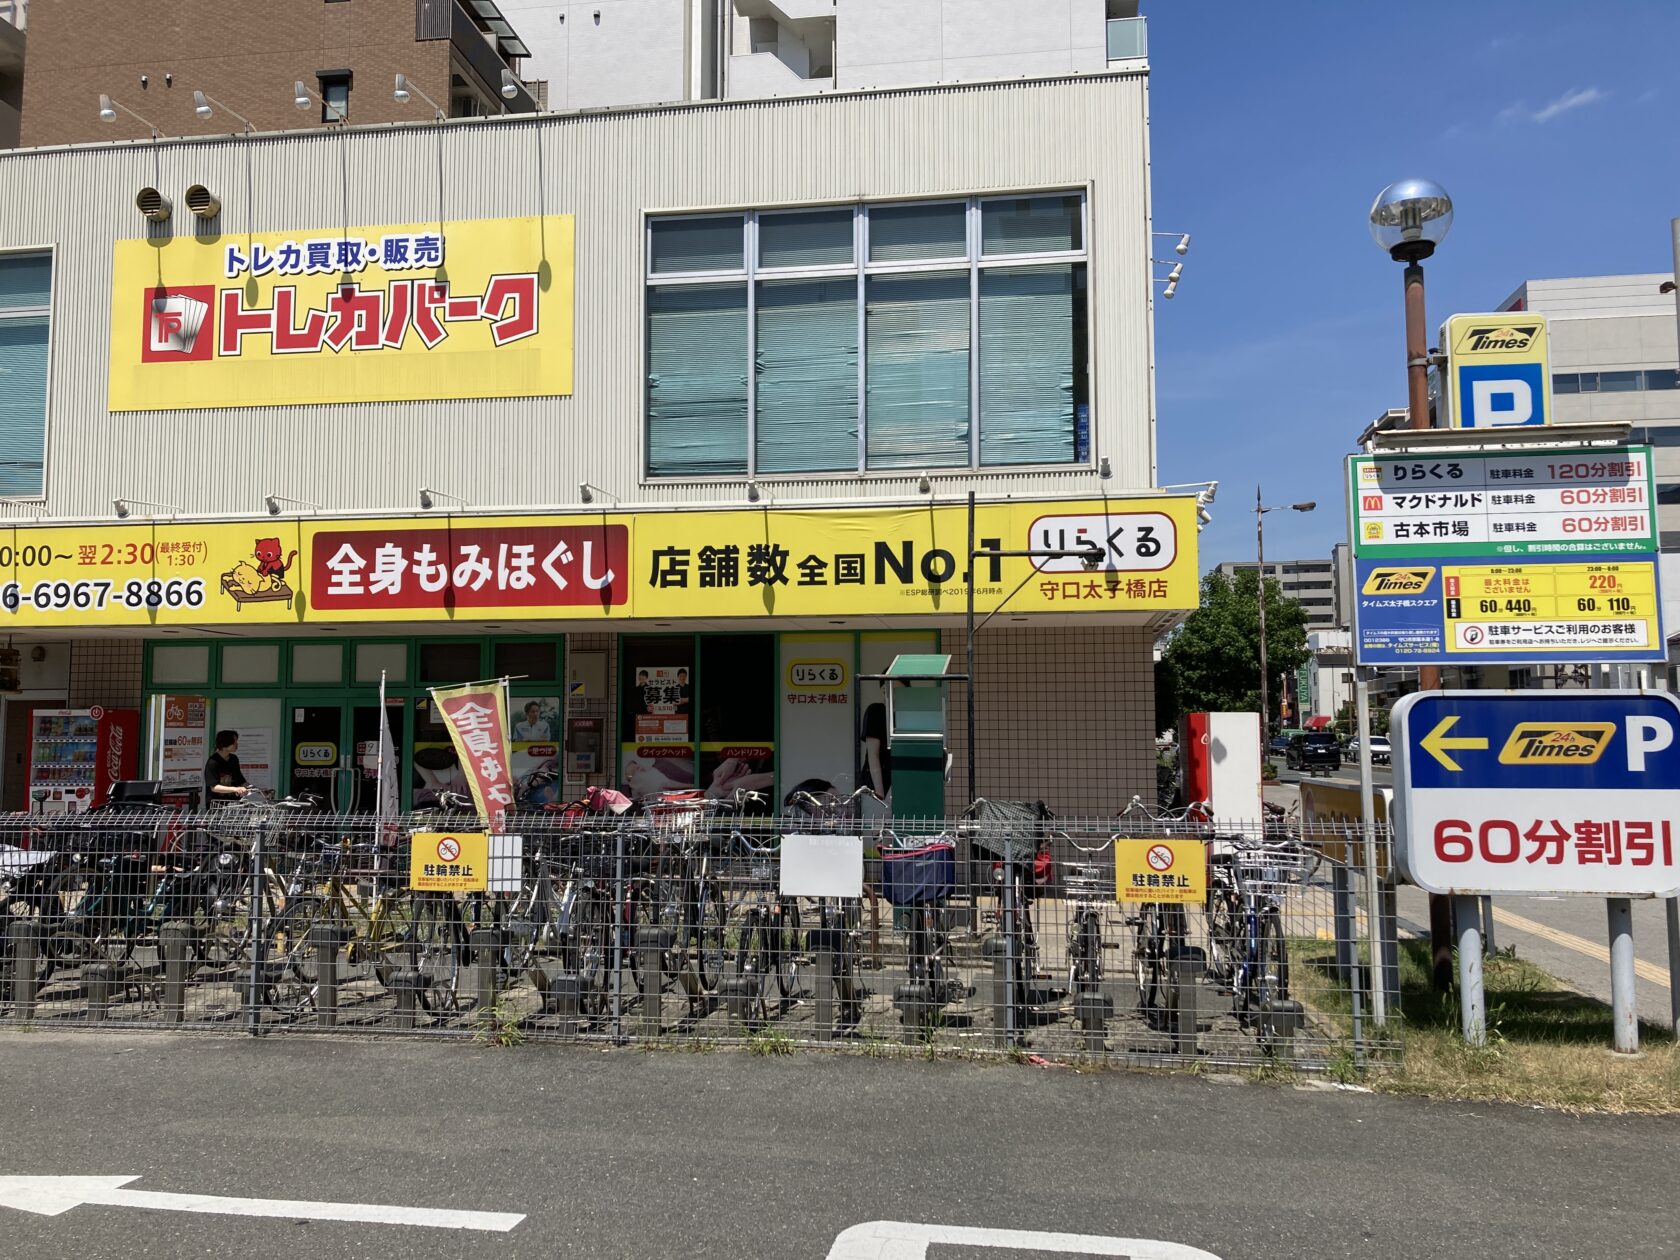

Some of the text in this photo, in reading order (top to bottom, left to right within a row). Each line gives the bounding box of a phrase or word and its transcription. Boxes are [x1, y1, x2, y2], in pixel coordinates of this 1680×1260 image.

[226, 235, 442, 275] トレカ買取・販売
[218, 272, 539, 357] トレカパーク
[1470, 333, 1530, 351] Times
[1393, 460, 1642, 481] りらくる 駐車料金 120分割引
[1392, 487, 1643, 509] マクドナルド 駐車料金 60分割引
[1393, 515, 1645, 538] 古本市場 駐車料金 60分割引
[1043, 526, 1161, 559] りらくる
[167, 554, 195, 567] 1:30
[325, 540, 615, 595] 全身もみほぐし
[1040, 578, 1168, 600] 守口太子橋店
[1375, 576, 1423, 591] Times
[1488, 623, 1636, 636] 駐車サービスご利用のお客様
[796, 667, 839, 681] りらくる
[645, 686, 680, 705] 募集
[787, 694, 847, 705] 守口太子橋店
[301, 748, 331, 758] りらくる
[1519, 715, 1674, 772] Times P
[1434, 819, 1673, 866] 60分割引
[424, 864, 473, 876] 駐輪禁止
[1132, 873, 1190, 887] 駐輪禁止
